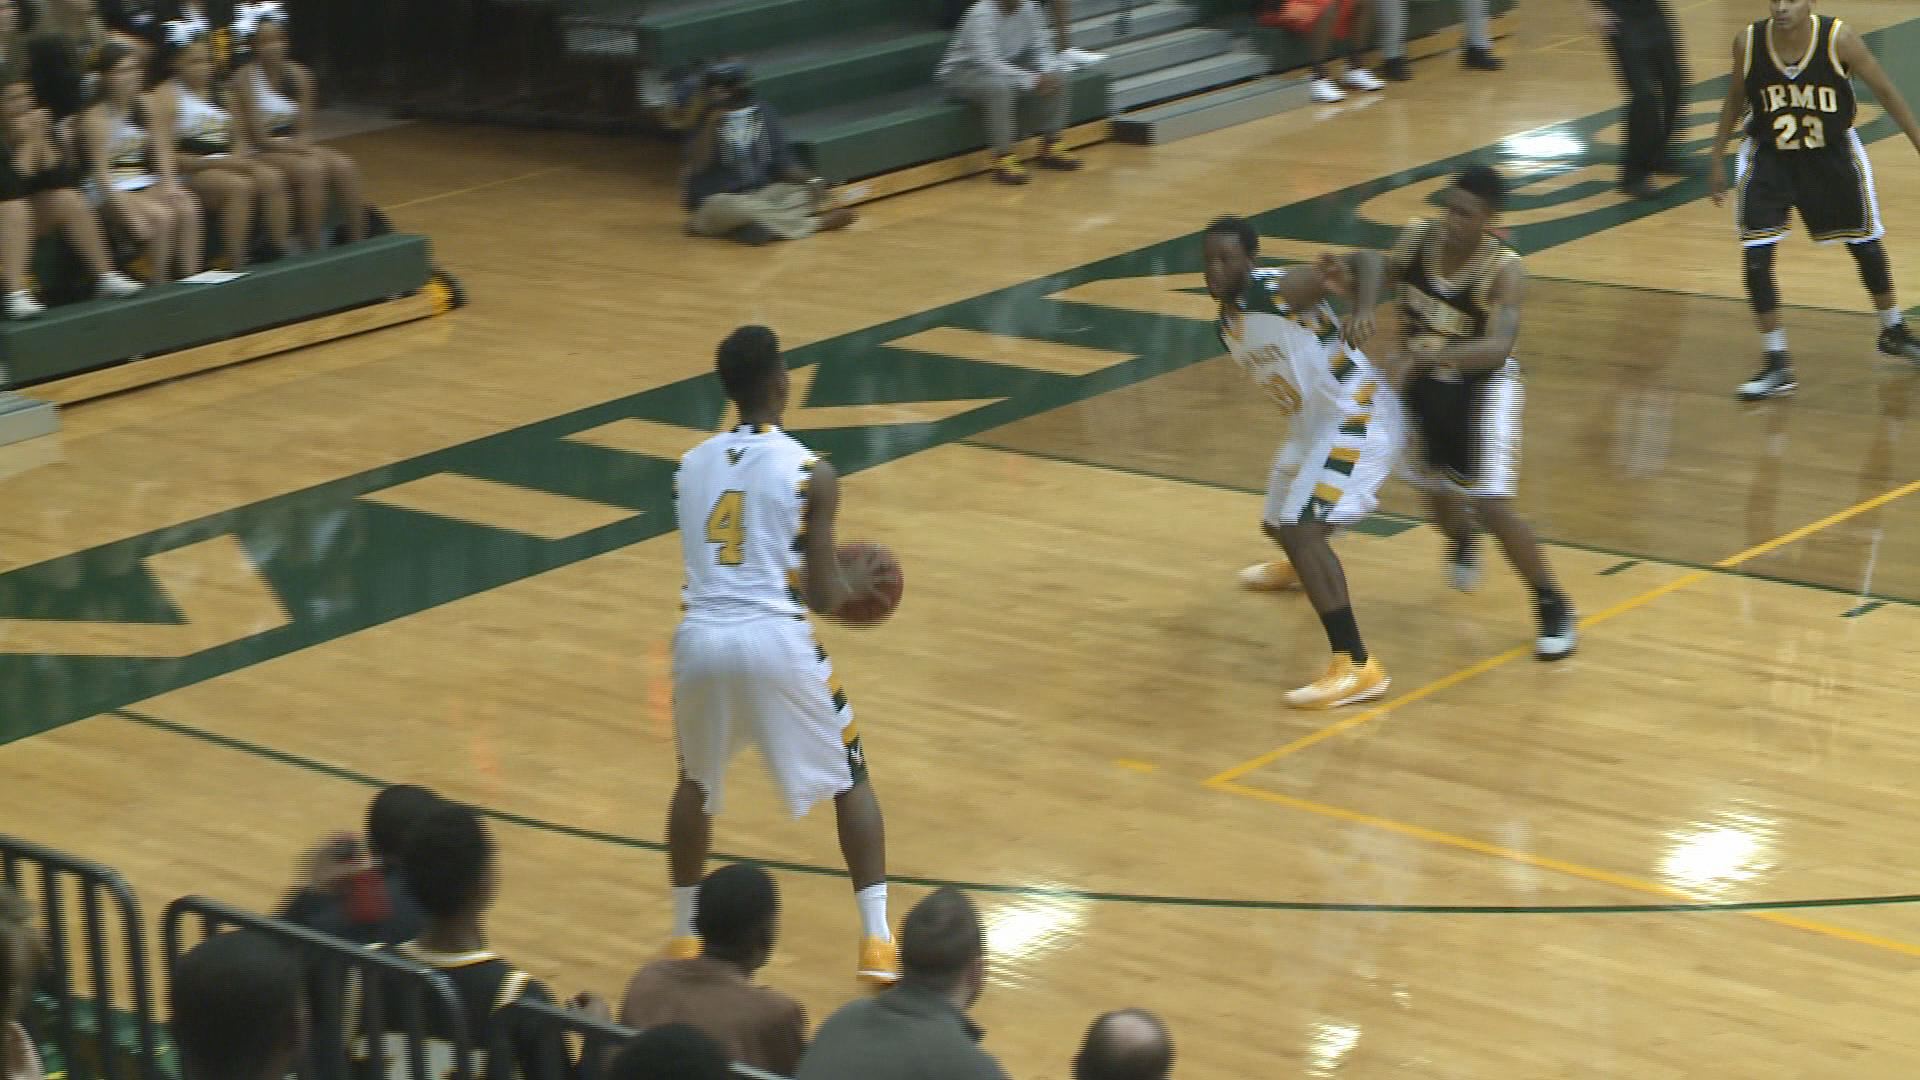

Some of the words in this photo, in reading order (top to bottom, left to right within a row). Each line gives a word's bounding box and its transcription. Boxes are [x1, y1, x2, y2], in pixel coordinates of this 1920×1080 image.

[1760, 83, 1838, 113] IRMO
[1773, 113, 1826, 150] 23
[705, 490, 747, 565] 4
